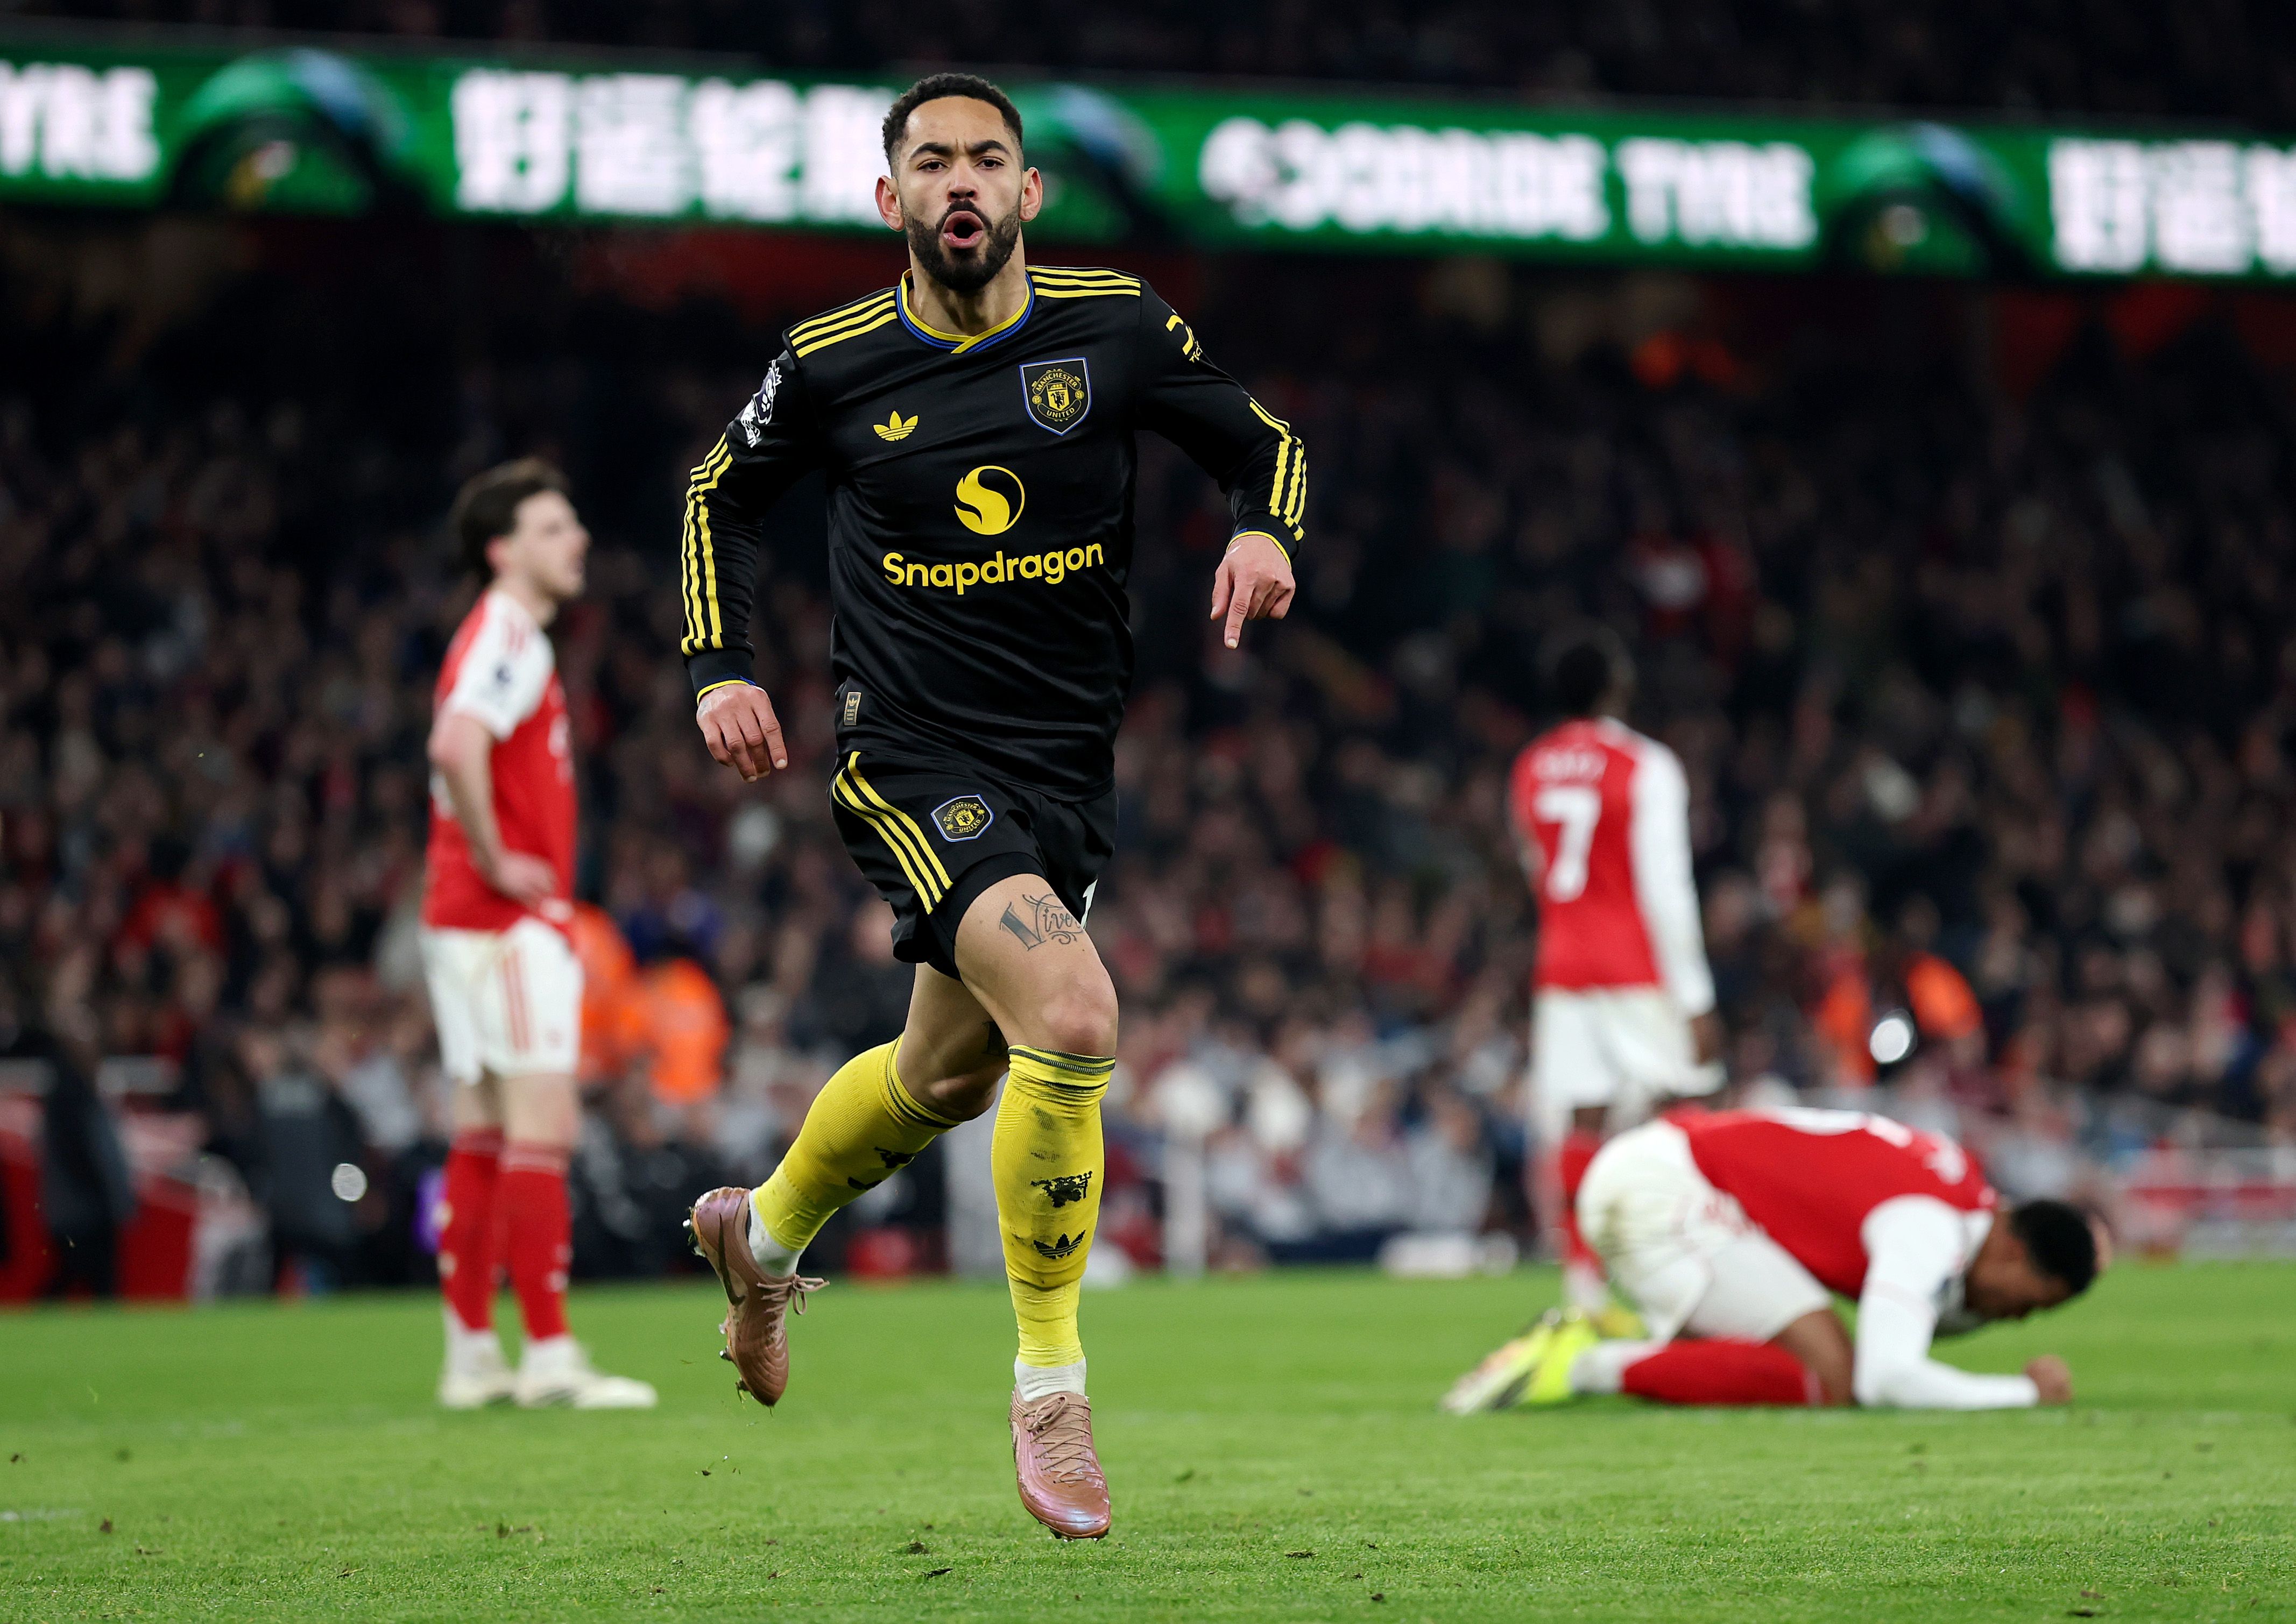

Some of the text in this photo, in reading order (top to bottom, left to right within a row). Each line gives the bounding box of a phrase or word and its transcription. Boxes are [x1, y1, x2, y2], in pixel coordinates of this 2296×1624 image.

[1035, 372, 1078, 392] MANCHESTER
[1047, 407, 1075, 418] UNITED
[882, 543, 1104, 595] Snapdragon
[946, 803, 978, 822] MANCHESTER
[958, 819, 981, 833] UNITED
[1534, 788, 1601, 900] 7
